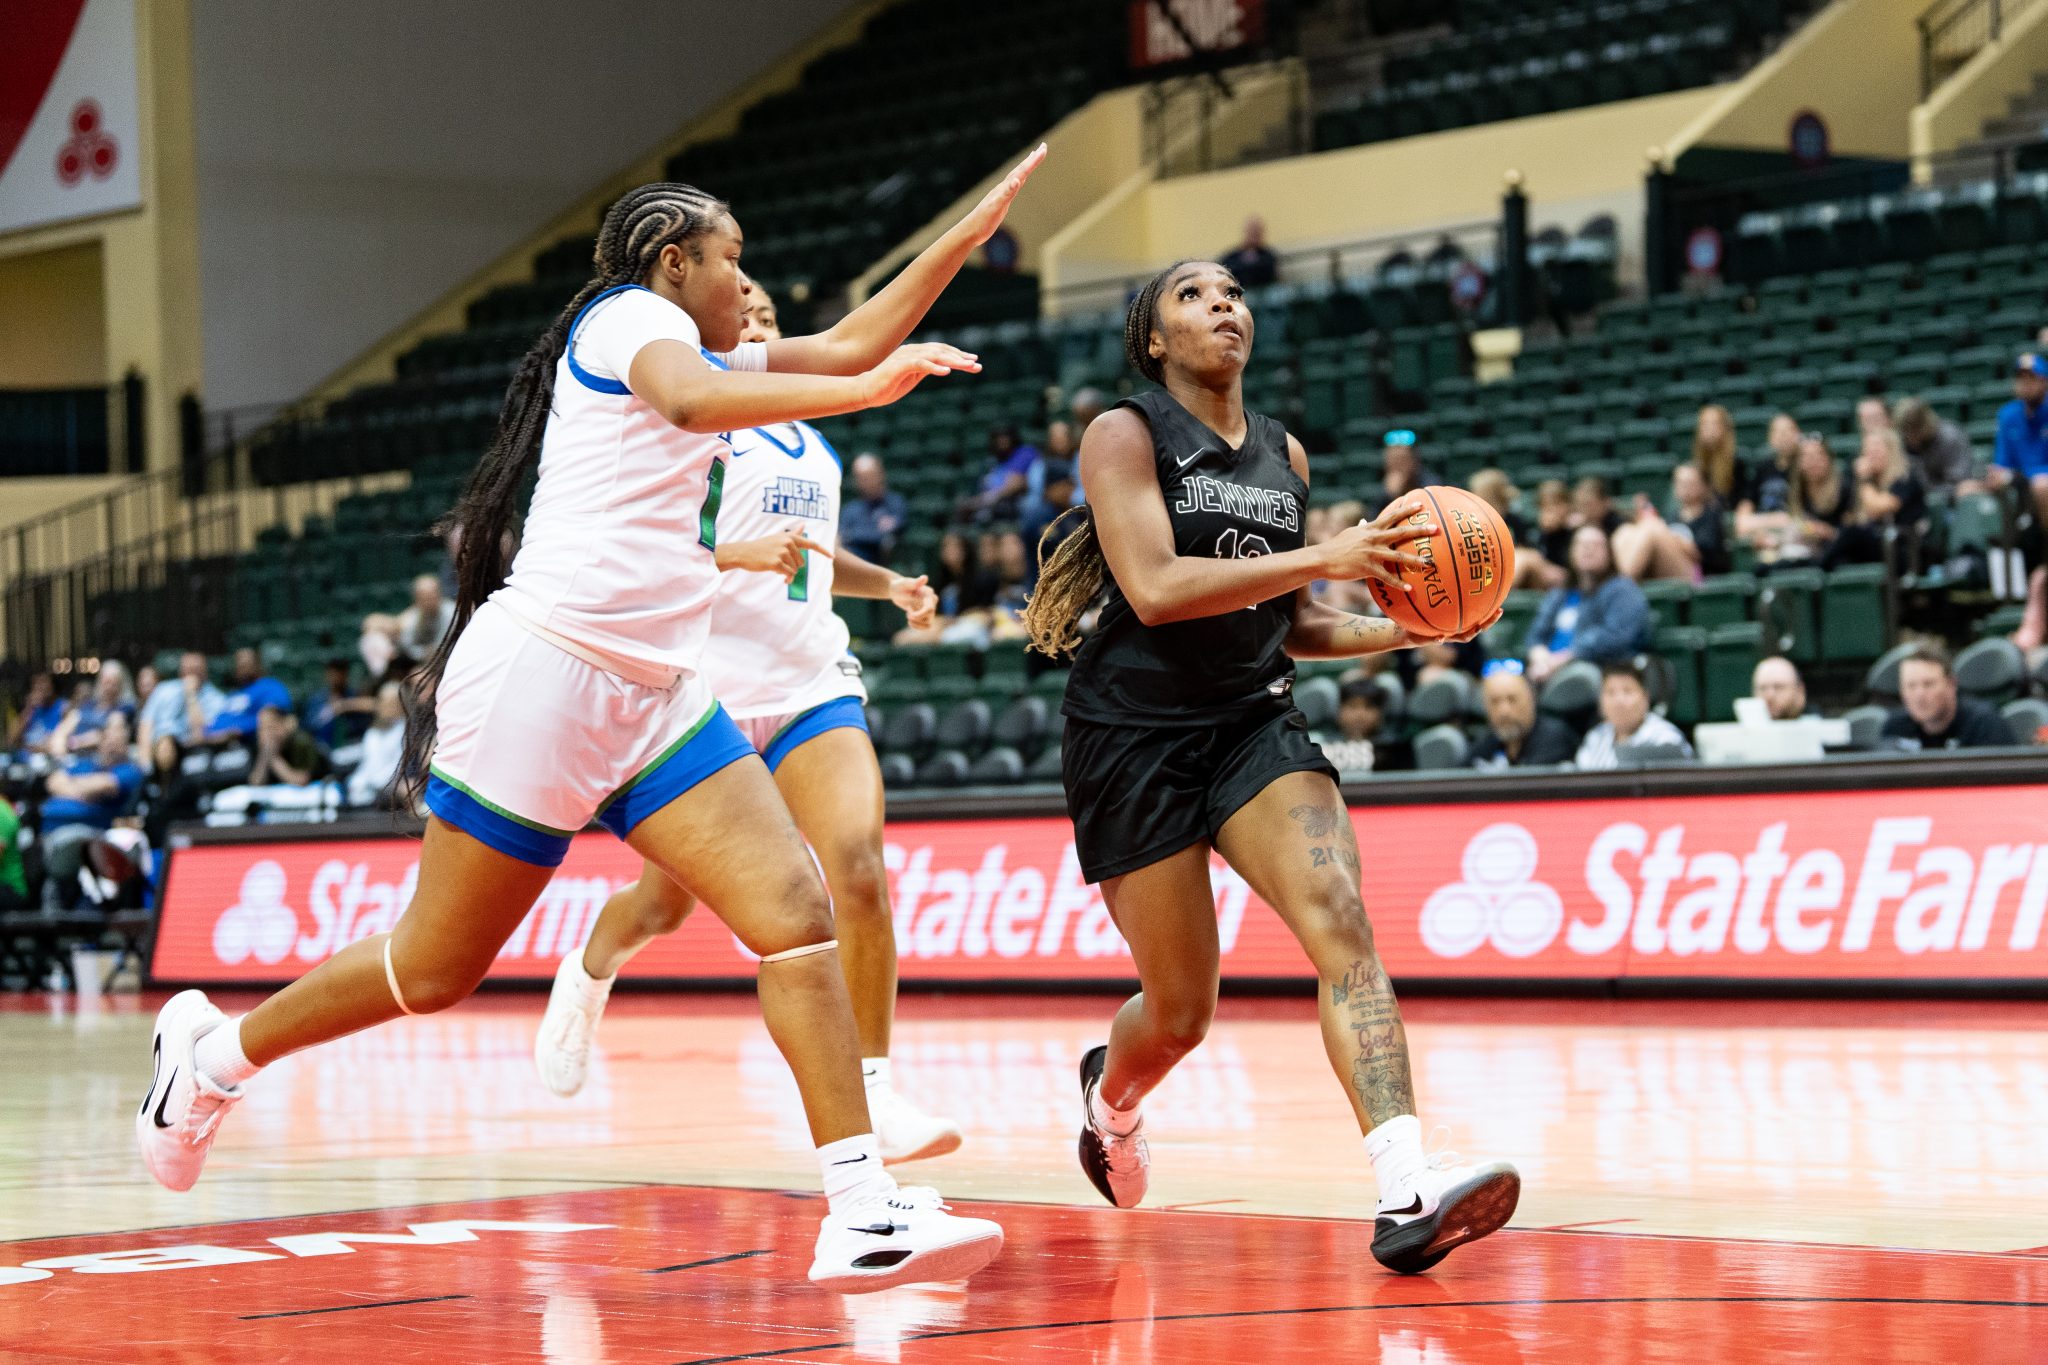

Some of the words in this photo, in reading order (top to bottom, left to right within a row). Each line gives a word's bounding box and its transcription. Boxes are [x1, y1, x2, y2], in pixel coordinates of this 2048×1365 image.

[762, 487, 829, 520] FLORIDA
[777, 477, 820, 500] WEST
[1176, 475, 1299, 533] JENNIES
[1452, 510, 1482, 594] LEGACY
[1840, 816, 2048, 955] Far
[1358, 1025, 1397, 1058] God
